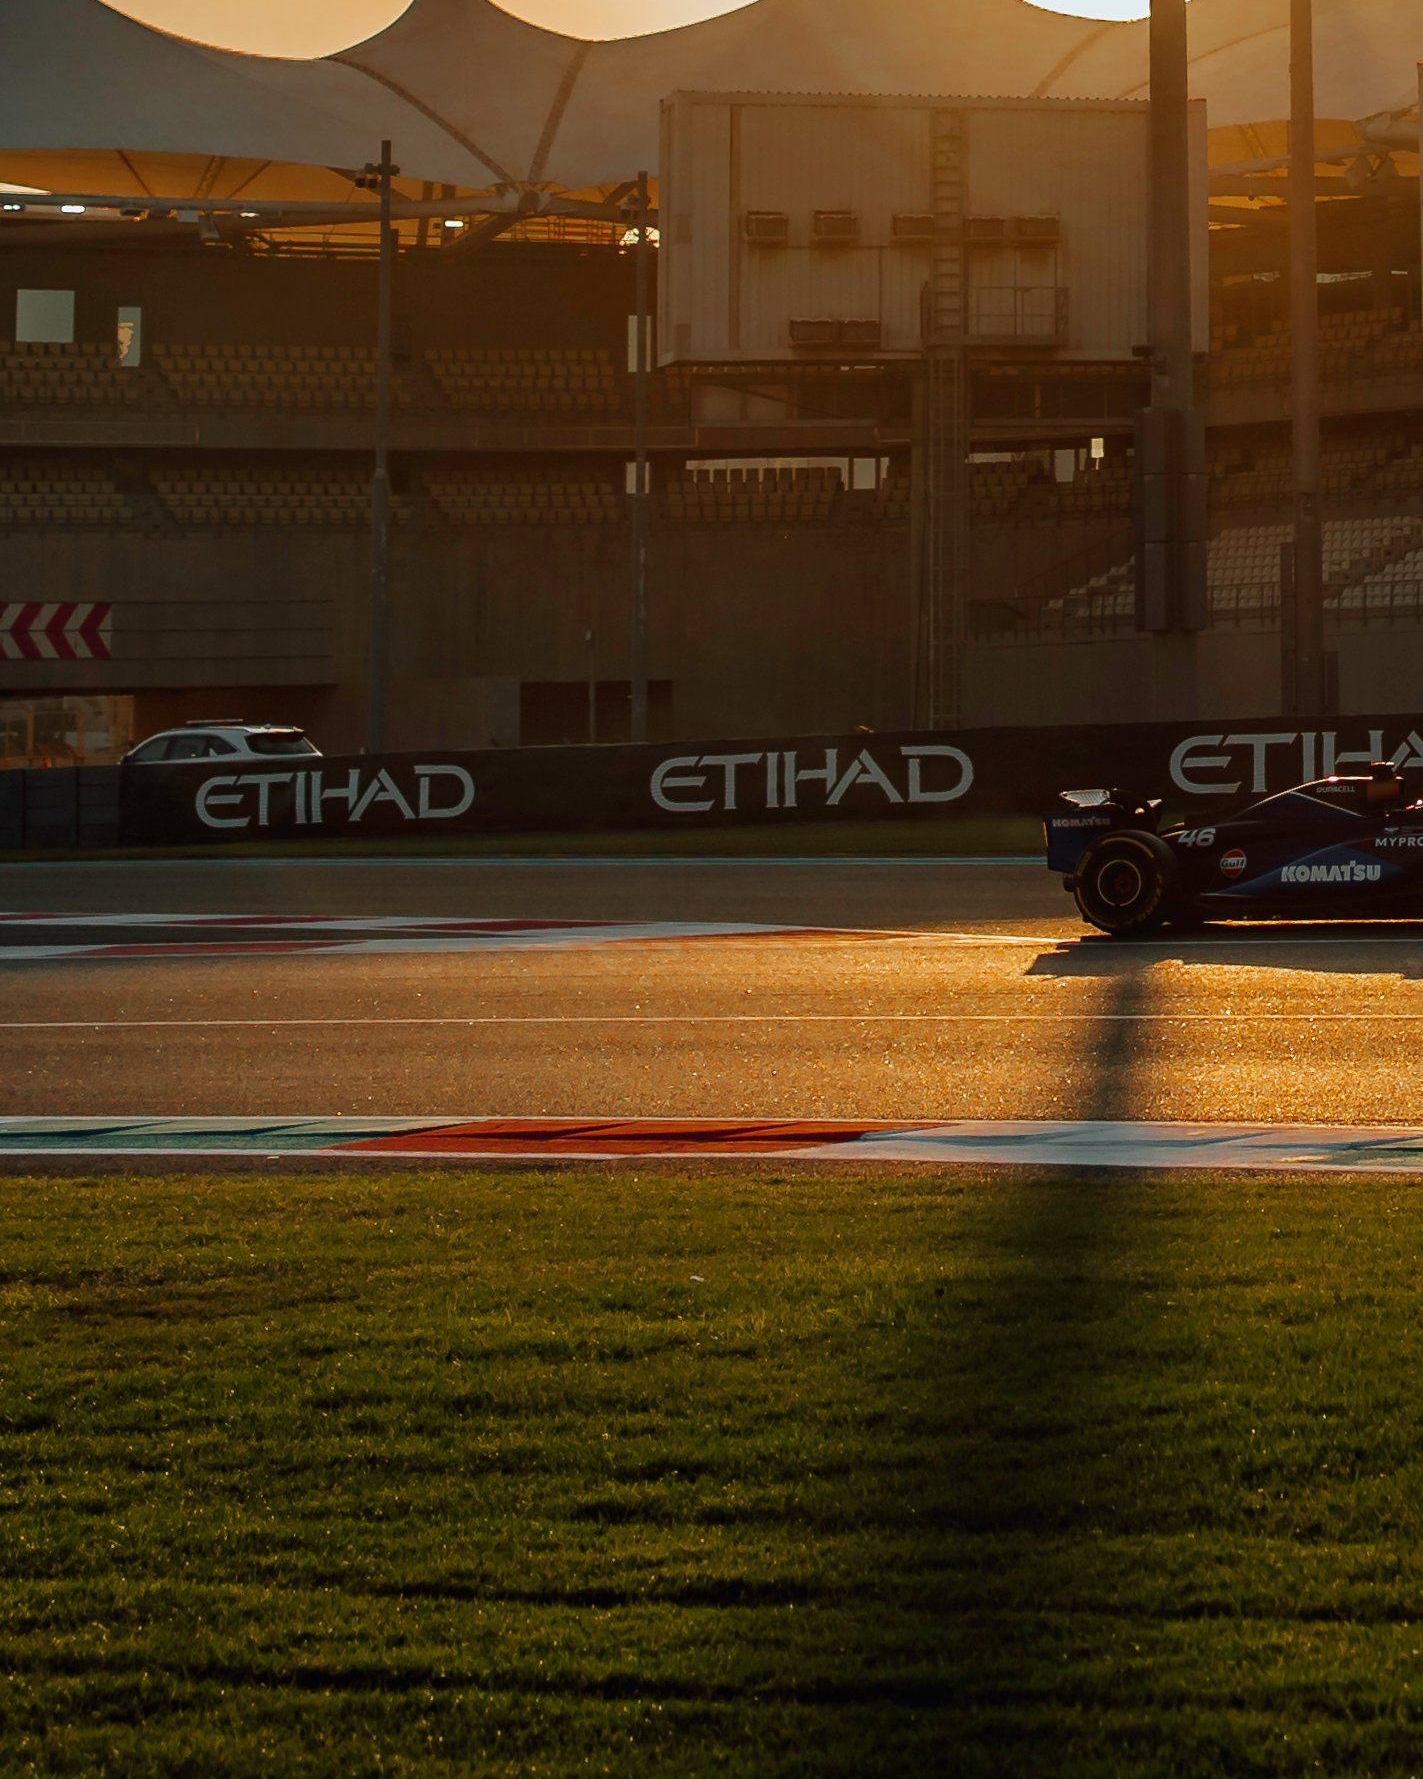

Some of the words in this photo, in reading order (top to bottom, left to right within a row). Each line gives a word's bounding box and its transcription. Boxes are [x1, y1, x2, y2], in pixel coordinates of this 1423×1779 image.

[650, 745, 974, 811] ETIHAD
[195, 764, 475, 828] ETIHAD
[1177, 827, 1216, 848] 46
[1220, 857, 1247, 870] Gulf
[1280, 860, 1381, 882] KOMATSU
